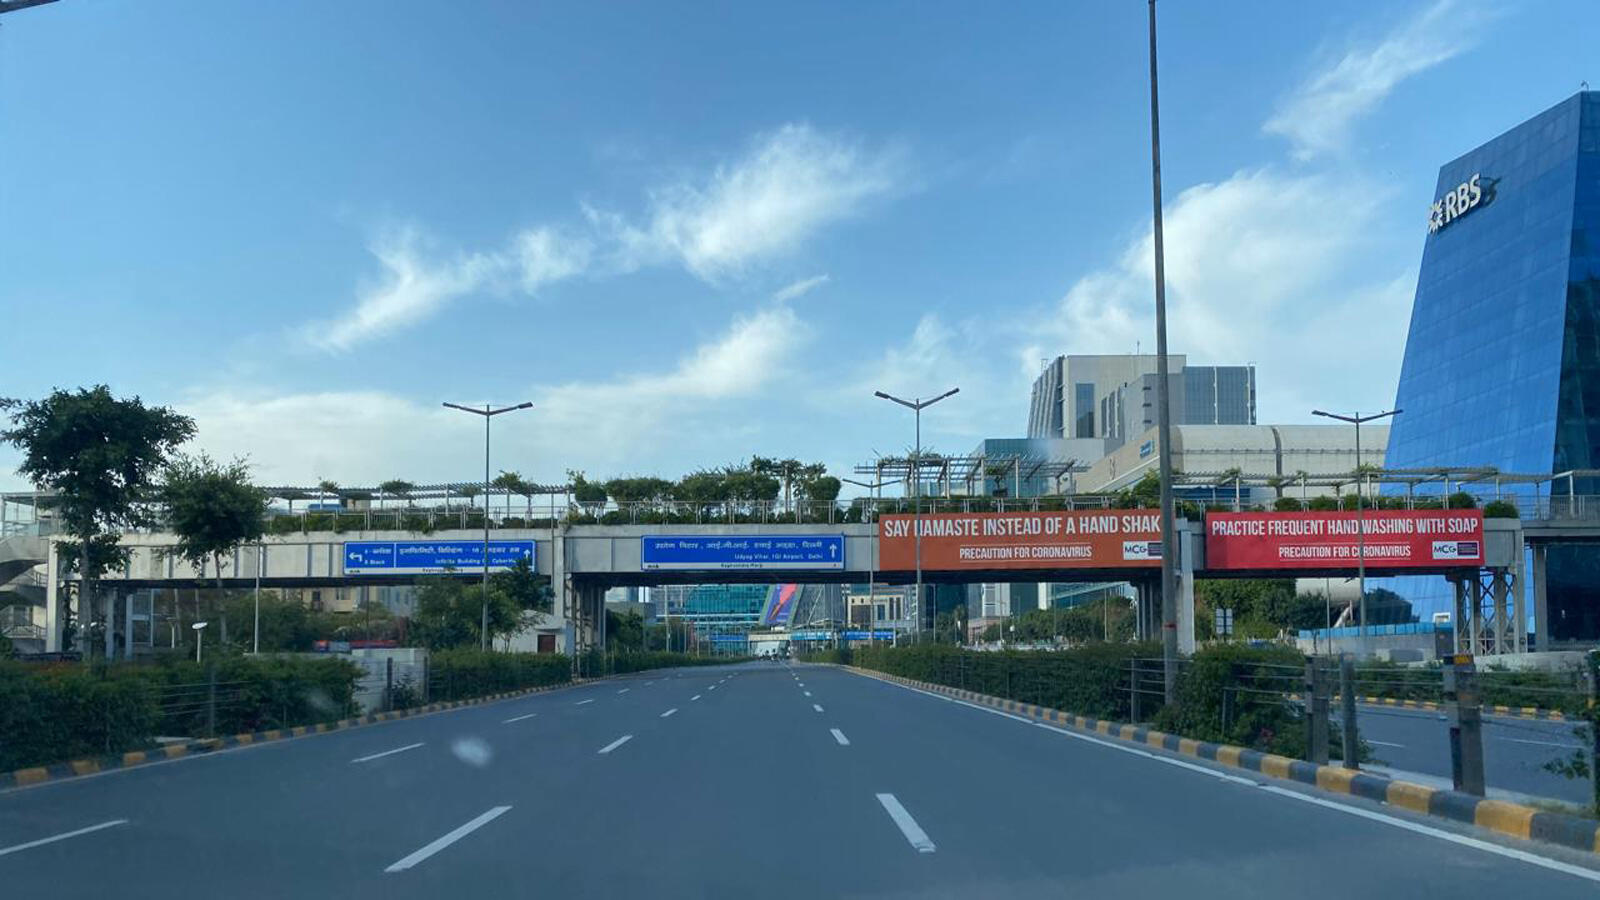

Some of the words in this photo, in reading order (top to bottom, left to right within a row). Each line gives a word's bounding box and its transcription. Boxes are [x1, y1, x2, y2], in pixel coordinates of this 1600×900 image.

[1445, 173, 1481, 223] RBS
[884, 519, 910, 537] SAY
[914, 518, 979, 537] NAMASTE
[983, 516, 1041, 536] INSTEAD
[1045, 516, 1062, 535] OF
[1066, 516, 1076, 535] A
[1079, 515, 1118, 534] HAND
[1122, 515, 1161, 533] SHAK
[1212, 519, 1265, 536] PRACTICE
[1268, 519, 1325, 536] FREQUENT
[1328, 519, 1359, 535] HAND
[1361, 518, 1414, 535] WASHING
[1415, 517, 1445, 534] WITH
[1448, 517, 1479, 534] SOAP
[960, 547, 1012, 560] PRECAUTION
[1014, 546, 1030, 559] FOR
[1032, 545, 1093, 559] CORONAVIRUS
[1124, 544, 1147, 555] MCG
[1279, 546, 1331, 559] PRECAUTION
[1333, 545, 1350, 558] FOR
[1433, 544, 1456, 555] MCG
